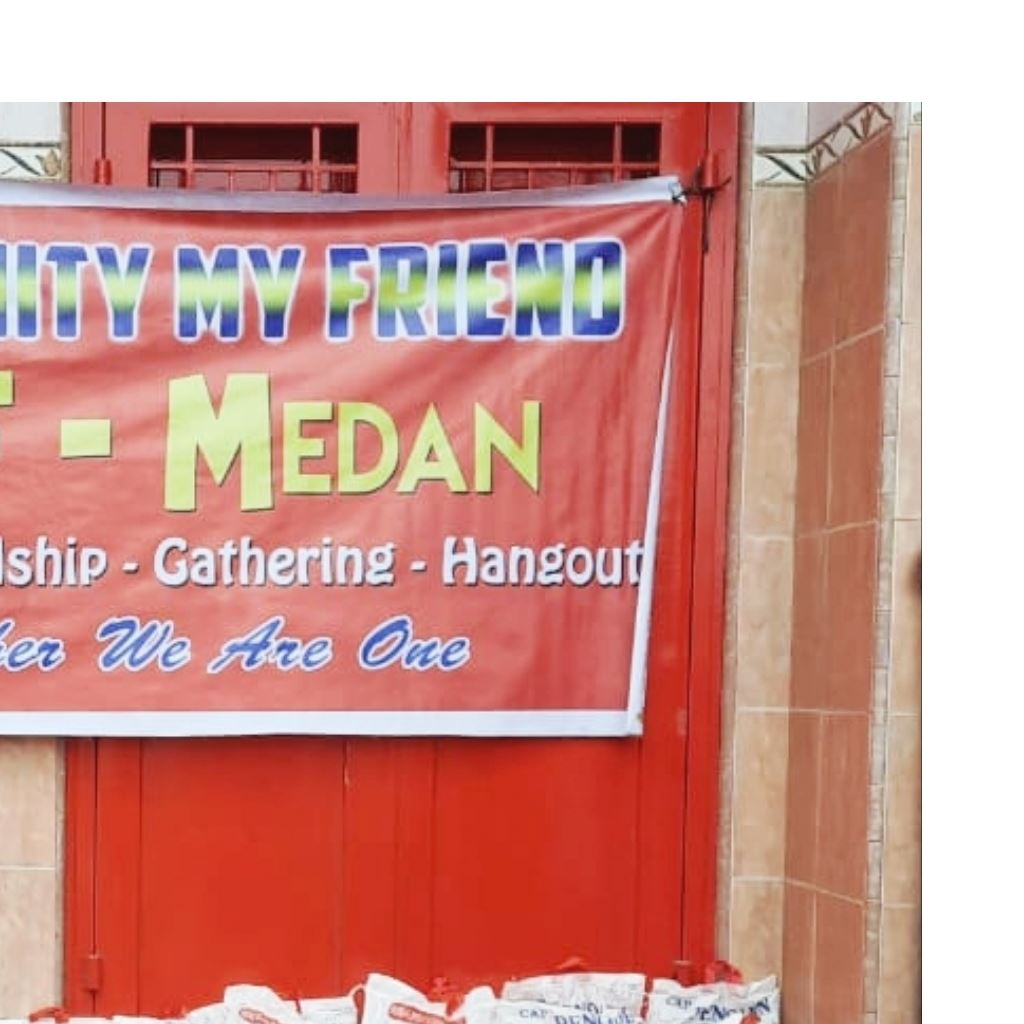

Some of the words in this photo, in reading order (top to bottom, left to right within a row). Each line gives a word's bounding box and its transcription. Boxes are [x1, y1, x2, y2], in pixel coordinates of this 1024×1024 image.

[175, 242, 305, 341] MY
[324, 236, 626, 342] FRIEND
[154, 536, 396, 587] Gathering
[441, 536, 645, 587] Hangout
[96, 615, 192, 672] We
[206, 615, 334, 674] Are
[358, 614, 472, 671] One
